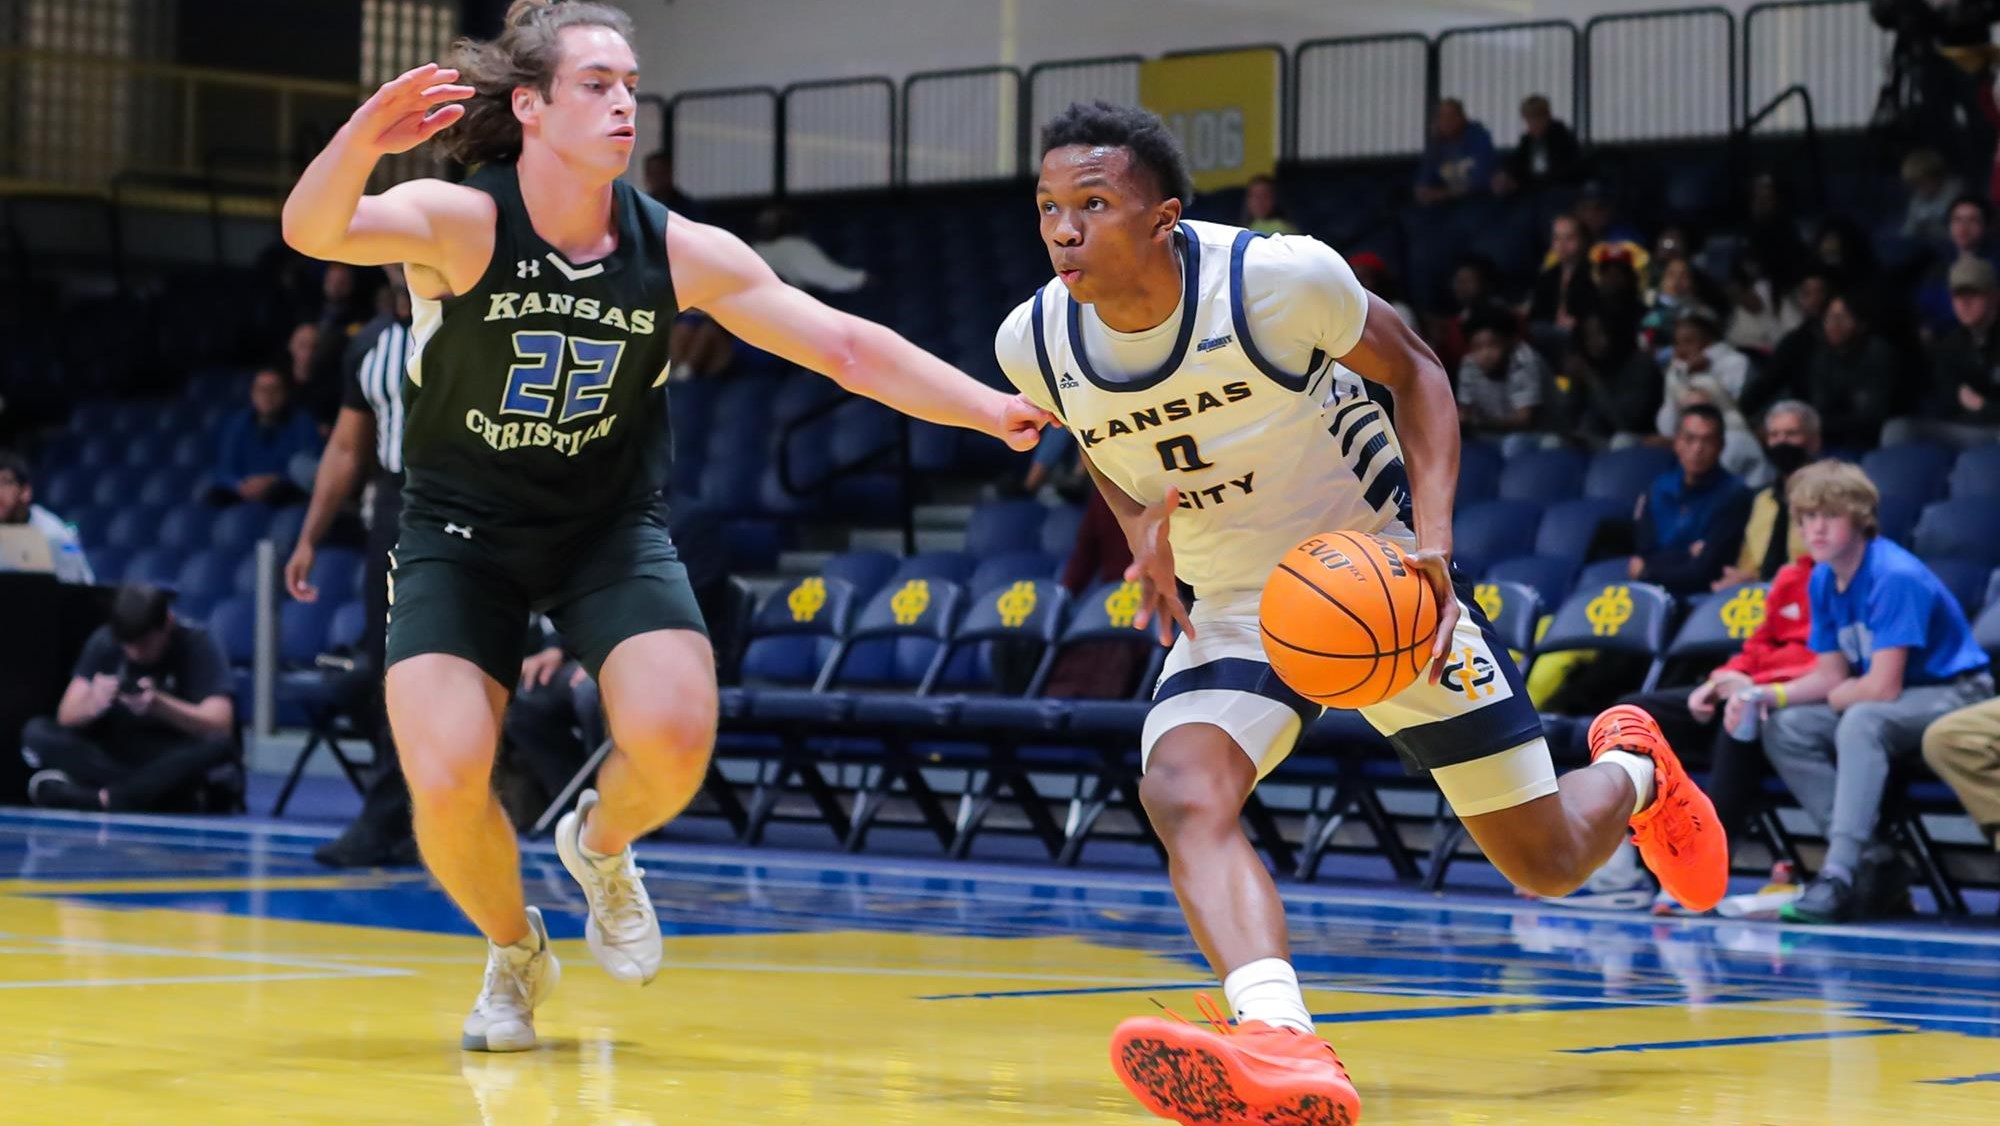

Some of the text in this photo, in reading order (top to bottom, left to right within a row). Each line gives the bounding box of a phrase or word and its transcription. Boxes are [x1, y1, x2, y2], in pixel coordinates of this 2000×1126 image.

[484, 291, 656, 335] KANSAS
[499, 330, 626, 425] 22
[465, 408, 616, 457] CHRISTIAN
[1079, 381, 1252, 448] KANSAS
[1298, 539, 1351, 570] EVO
